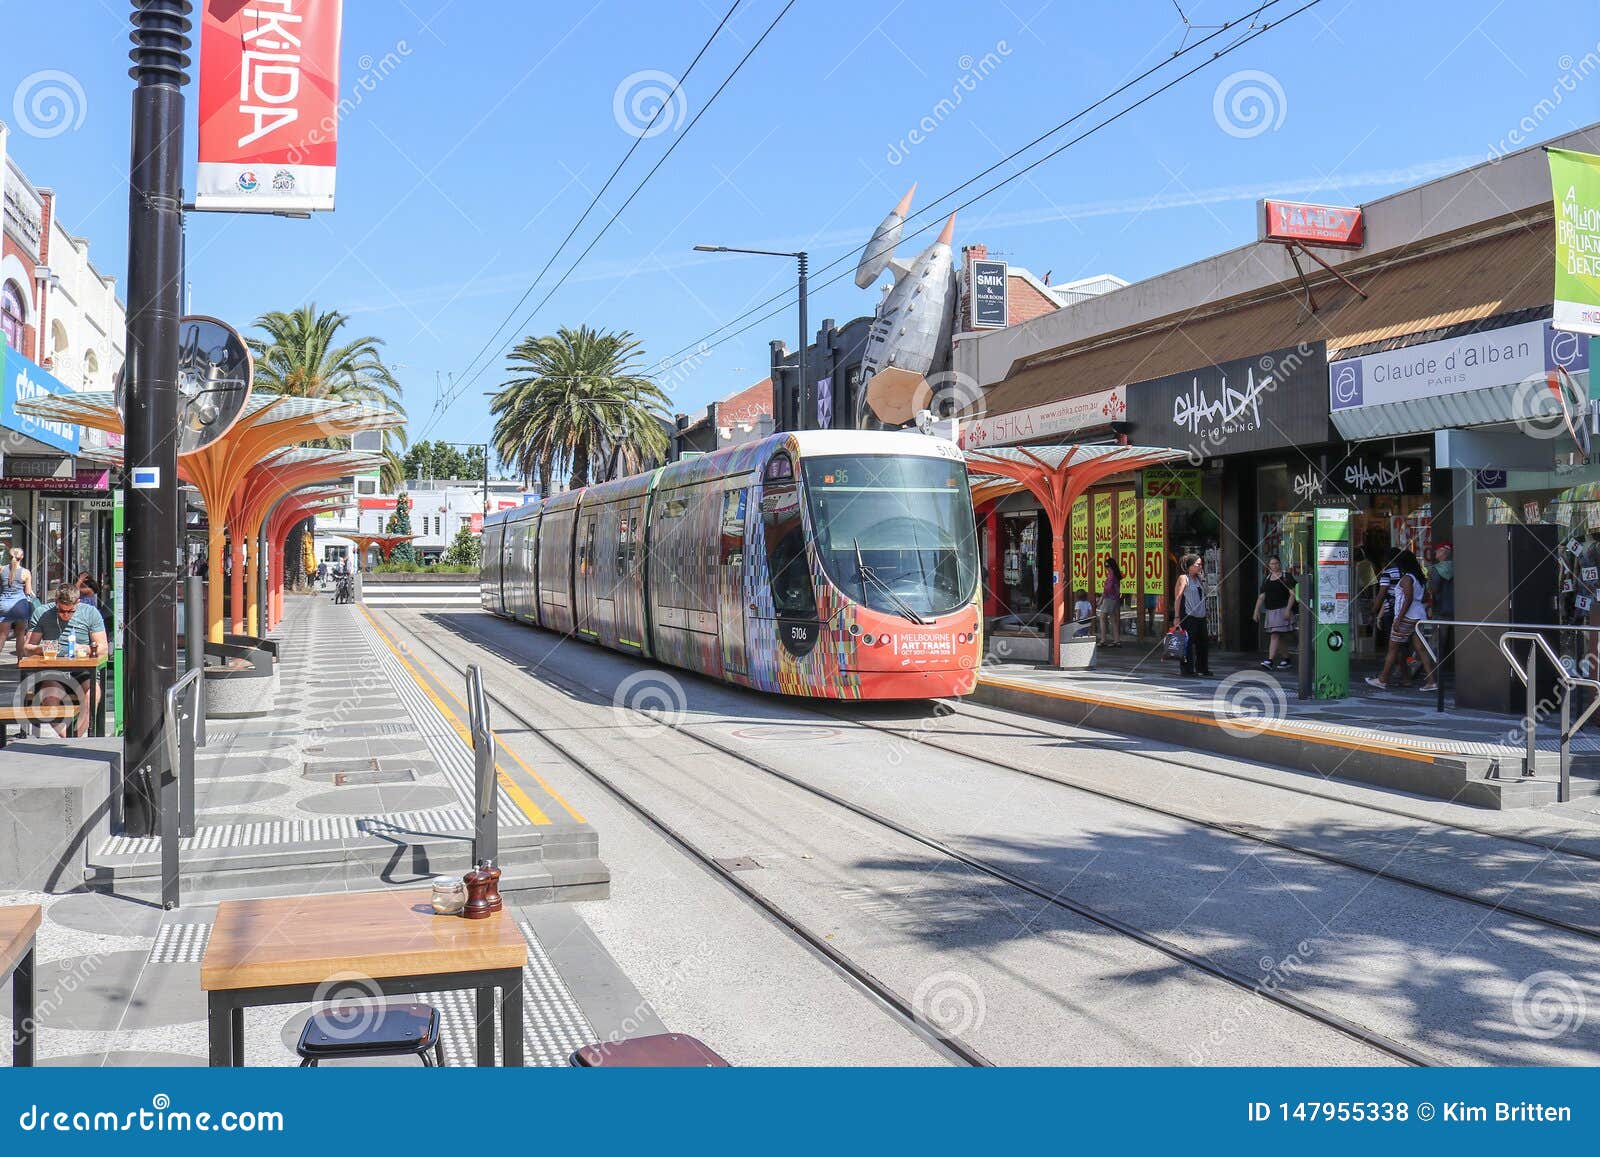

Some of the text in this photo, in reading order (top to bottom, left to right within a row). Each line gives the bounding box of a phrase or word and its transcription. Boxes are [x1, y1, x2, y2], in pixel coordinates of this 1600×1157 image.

[1566, 186, 1576, 202] A
[978, 275, 1003, 286] SMIK
[1373, 358, 1437, 382] Claude
[1427, 373, 1466, 387] PARIS
[1200, 422, 1255, 438] CLOTHING
[834, 469, 849, 483] 96
[1073, 526, 1088, 541] SALE
[1096, 526, 1111, 541] SALE
[1119, 524, 1136, 540] SALE
[1145, 522, 1163, 539] SALE
[1074, 552, 1088, 578] 50
[1119, 551, 1136, 579] 50
[1145, 551, 1163, 580] 50
[1126, 580, 1136, 589] OFF
[1151, 581, 1162, 590] OFF
[791, 627, 807, 640] 5106
[900, 633, 950, 641] MELBOURNE
[901, 641, 951, 649] ART TRAMS
